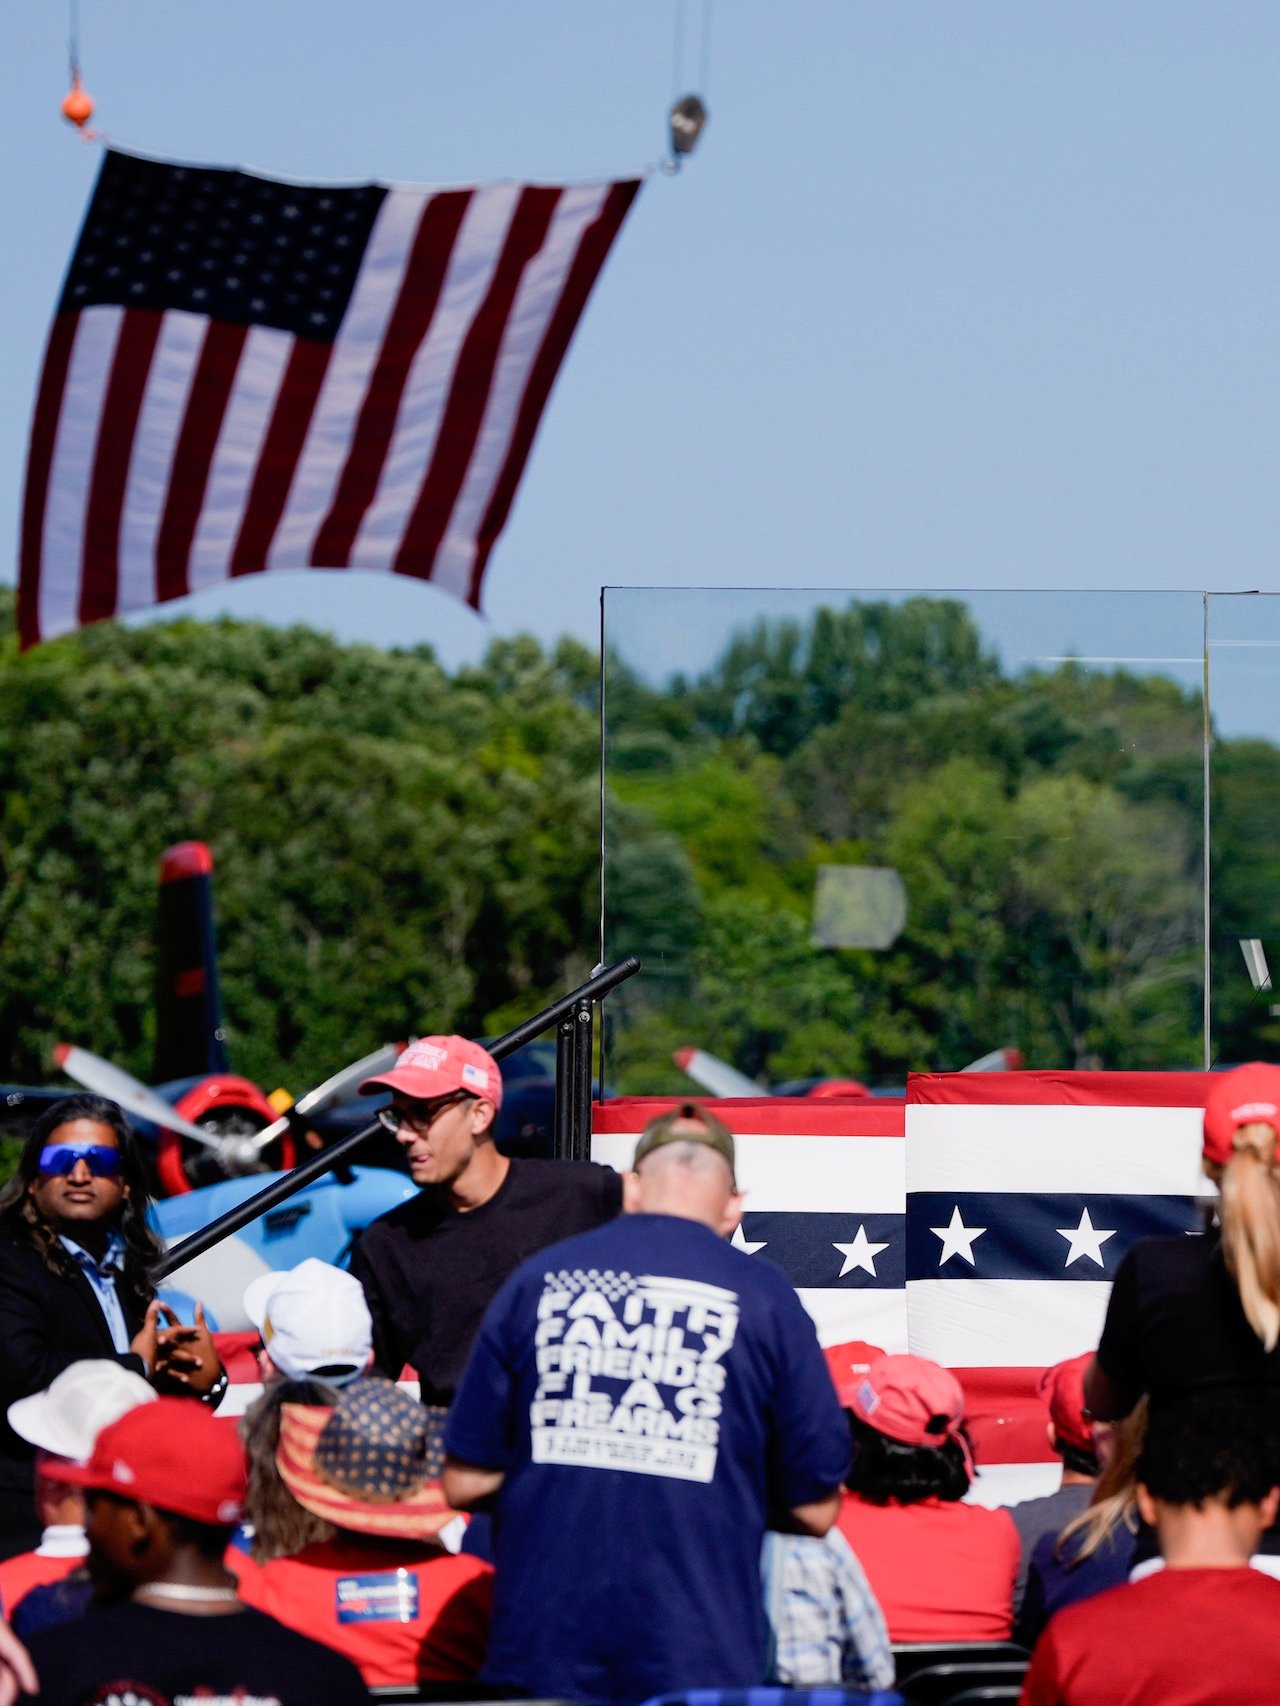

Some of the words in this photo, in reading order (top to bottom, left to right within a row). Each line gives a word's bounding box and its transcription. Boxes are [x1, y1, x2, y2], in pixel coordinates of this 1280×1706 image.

[535, 1317, 735, 1363] FAMILY
[537, 1290, 740, 1342] FAITH
[536, 1344, 728, 1393] FRIENDS
[535, 1371, 724, 1419] FLAG
[530, 1399, 721, 1446] FIREARMS
